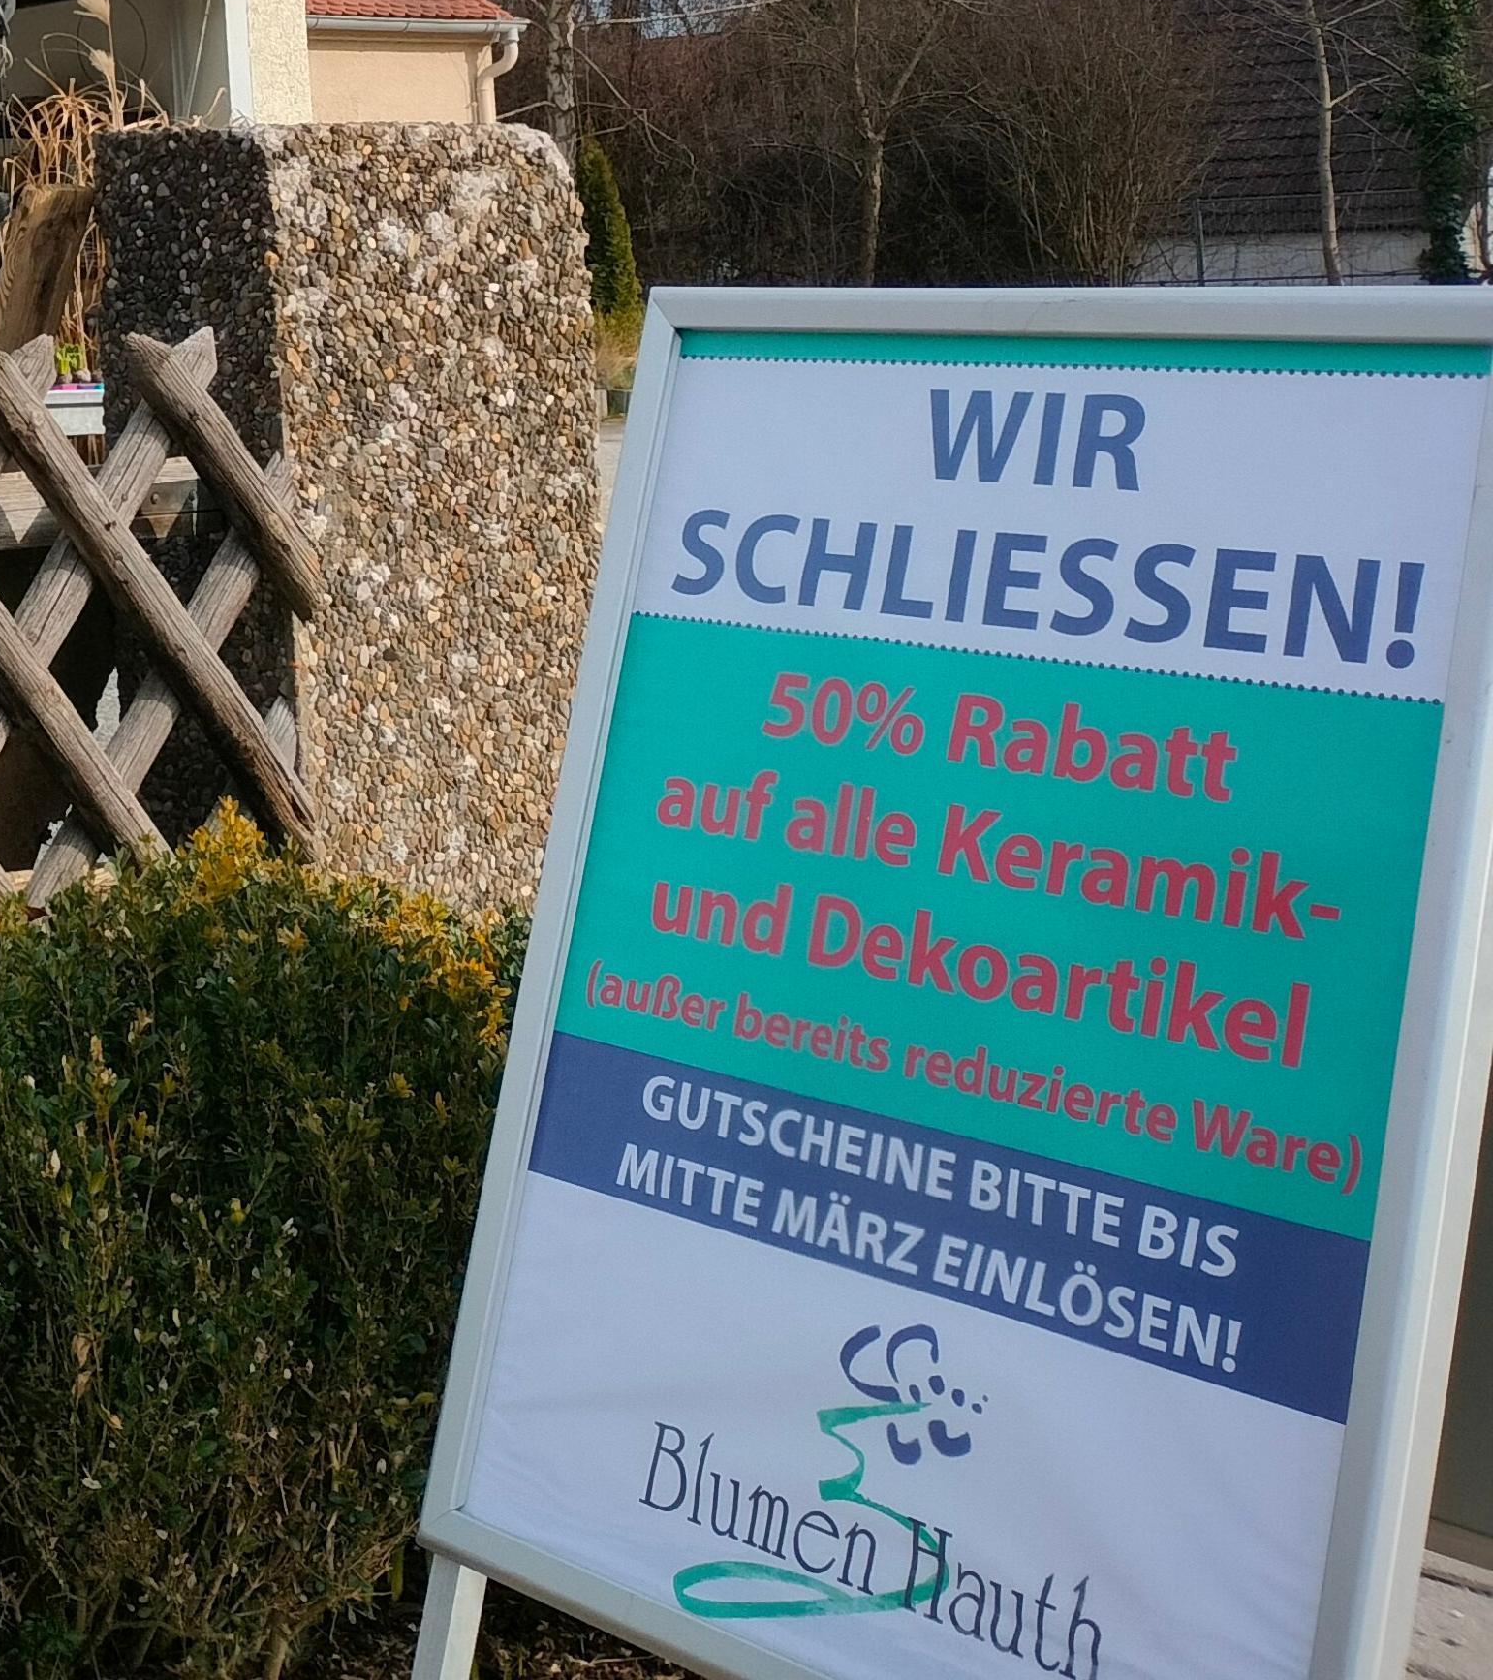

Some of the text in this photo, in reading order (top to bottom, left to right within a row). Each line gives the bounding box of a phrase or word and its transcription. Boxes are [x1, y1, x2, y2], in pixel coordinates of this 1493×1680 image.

[929, 389, 1147, 493] WIR
[670, 509, 1426, 670] SCHLIESSEN!
[761, 672, 1239, 804] 50% Rabatt
[655, 770, 1343, 942] auf alle Keramik-
[649, 880, 1311, 1071] und Dekoartikel
[585, 958, 1365, 1198] (außer bereits reduzierte Ware)
[615, 1142, 1243, 1376] MITTE MÄRZ EINLÖSEN!
[641, 1074, 1239, 1280] GUTSCHEINE BITTE BIS
[638, 1421, 1105, 1680] Blumen Hauth
